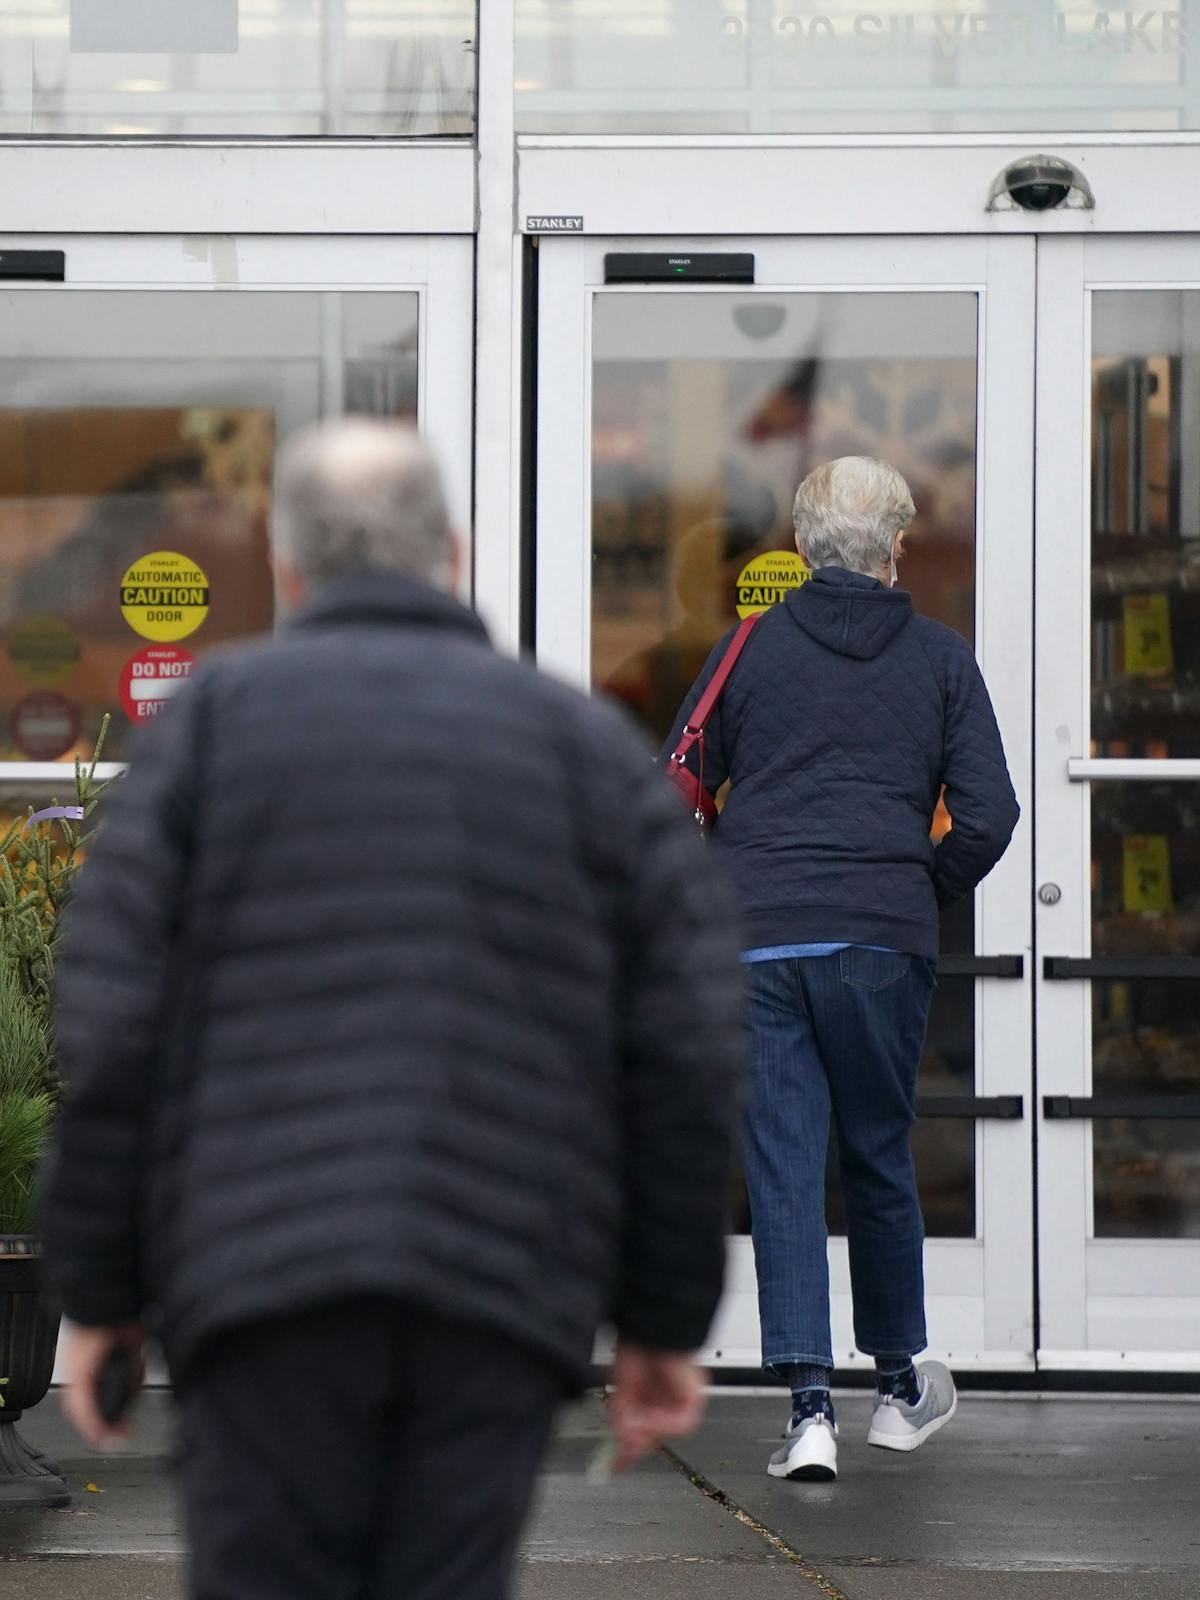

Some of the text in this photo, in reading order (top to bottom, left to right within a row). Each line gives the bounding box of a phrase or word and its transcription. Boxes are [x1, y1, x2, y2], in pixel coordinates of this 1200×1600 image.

[527, 218, 582, 229] STANLEY
[127, 571, 202, 583] AUTOMATIC
[743, 570, 810, 582] AUTOMATI
[123, 588, 204, 604] CAUTION
[738, 587, 787, 604] CAUT
[146, 610, 182, 622] DOOR
[132, 661, 192, 677] DO NOT
